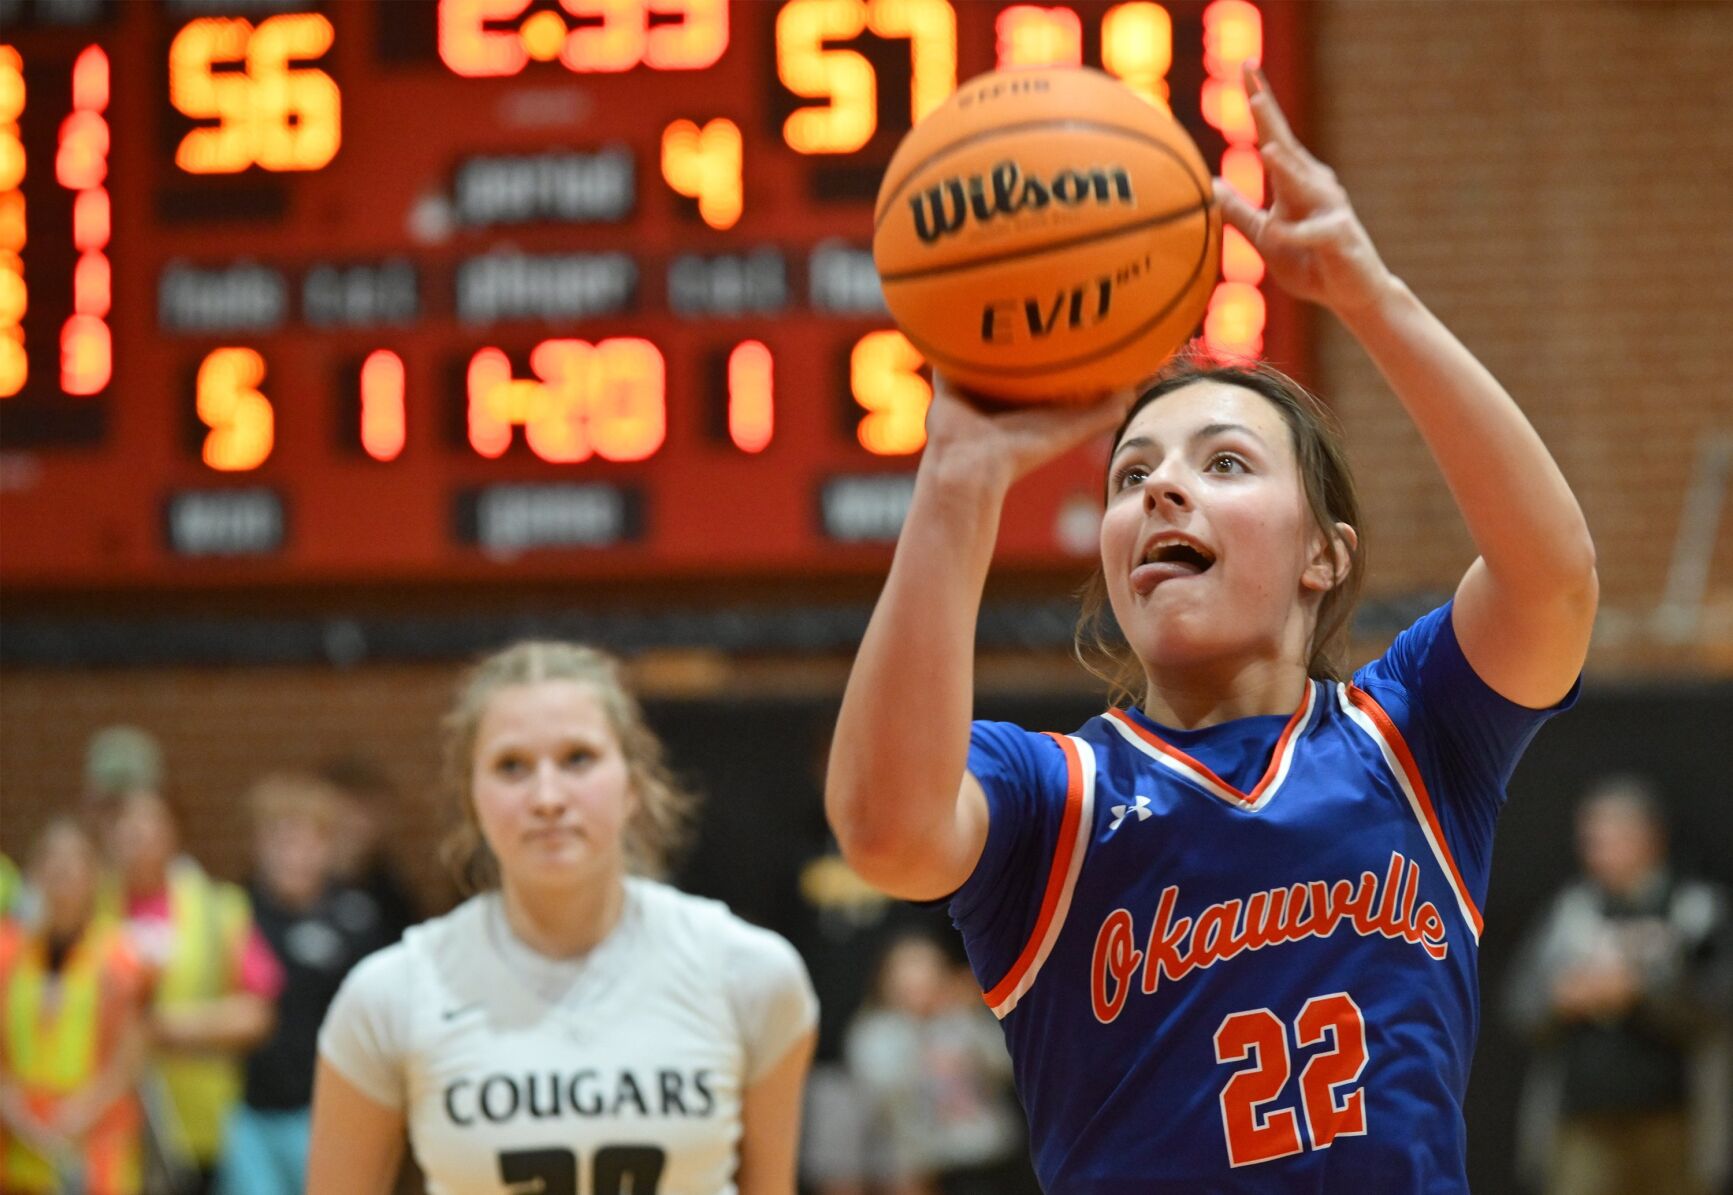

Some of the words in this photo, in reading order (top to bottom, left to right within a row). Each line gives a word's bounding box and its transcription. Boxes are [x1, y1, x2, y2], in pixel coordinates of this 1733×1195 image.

[169, 12, 341, 174] 56
[776, 0, 957, 154] 57
[661, 118, 743, 230] 4
[908, 162, 1135, 245] Wilson
[196, 347, 274, 471] 5
[361, 348, 405, 461] 1
[728, 340, 774, 453] 1
[850, 330, 933, 456] 5
[1091, 850, 1448, 1024] Okawville
[444, 1069, 716, 1126] COUGARS
[1213, 991, 1370, 1168] 22
